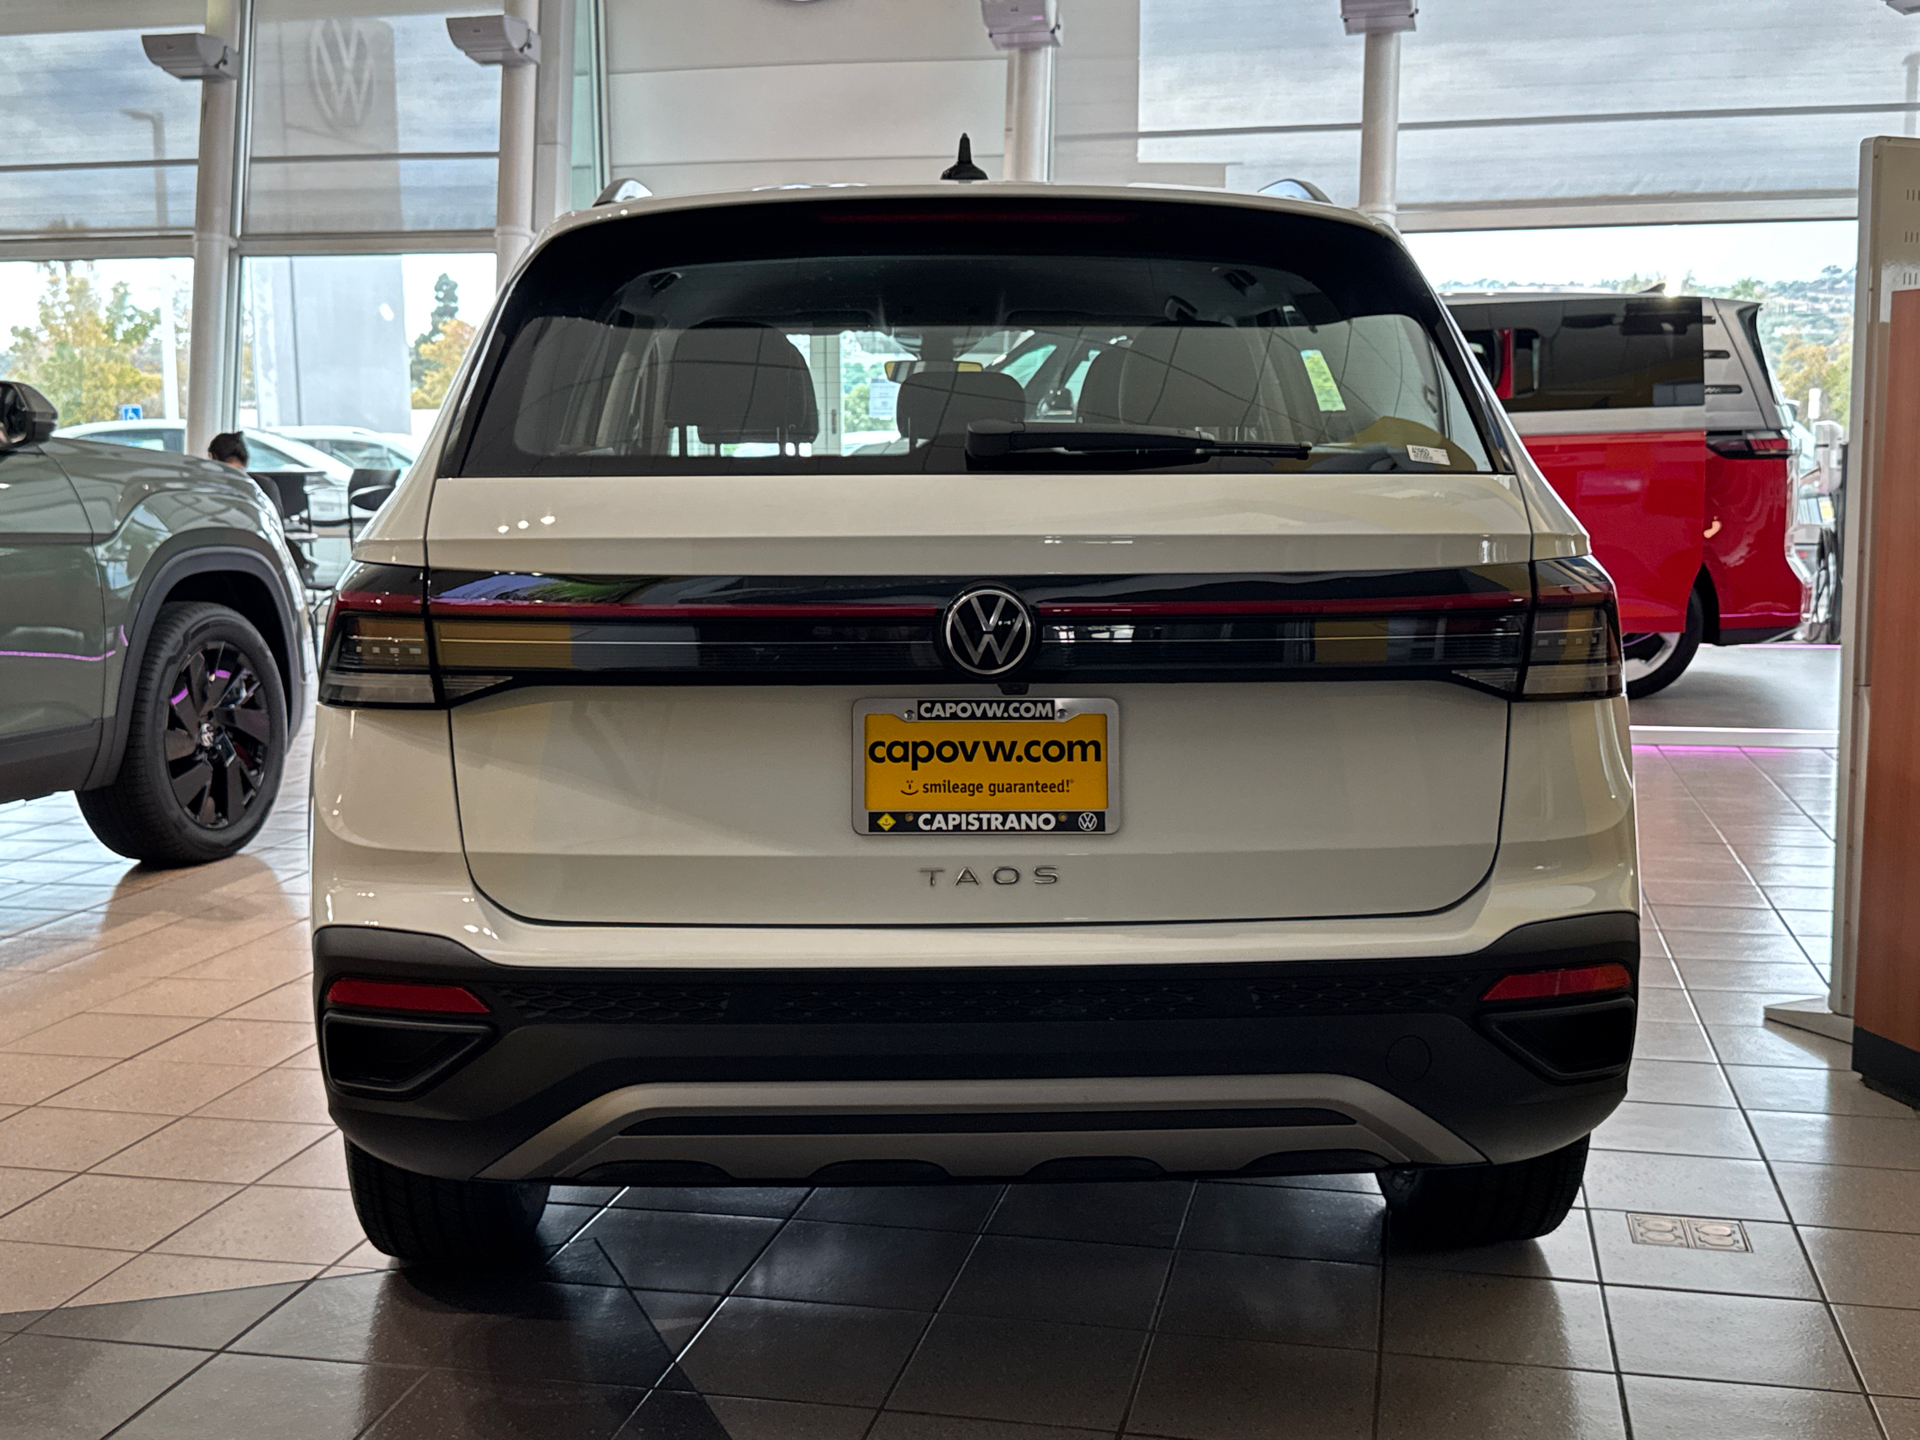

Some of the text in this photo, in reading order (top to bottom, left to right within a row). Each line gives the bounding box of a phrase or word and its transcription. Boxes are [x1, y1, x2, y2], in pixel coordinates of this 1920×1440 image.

[948, 592, 1028, 672] VW
[919, 702, 1054, 718] CAPOVW.COM
[868, 739, 1102, 771] capovw.com
[922, 780, 984, 797] smileage
[917, 813, 1056, 831] CAPISTRANO
[1078, 812, 1097, 831] VW
[919, 866, 1060, 886] TAOS
